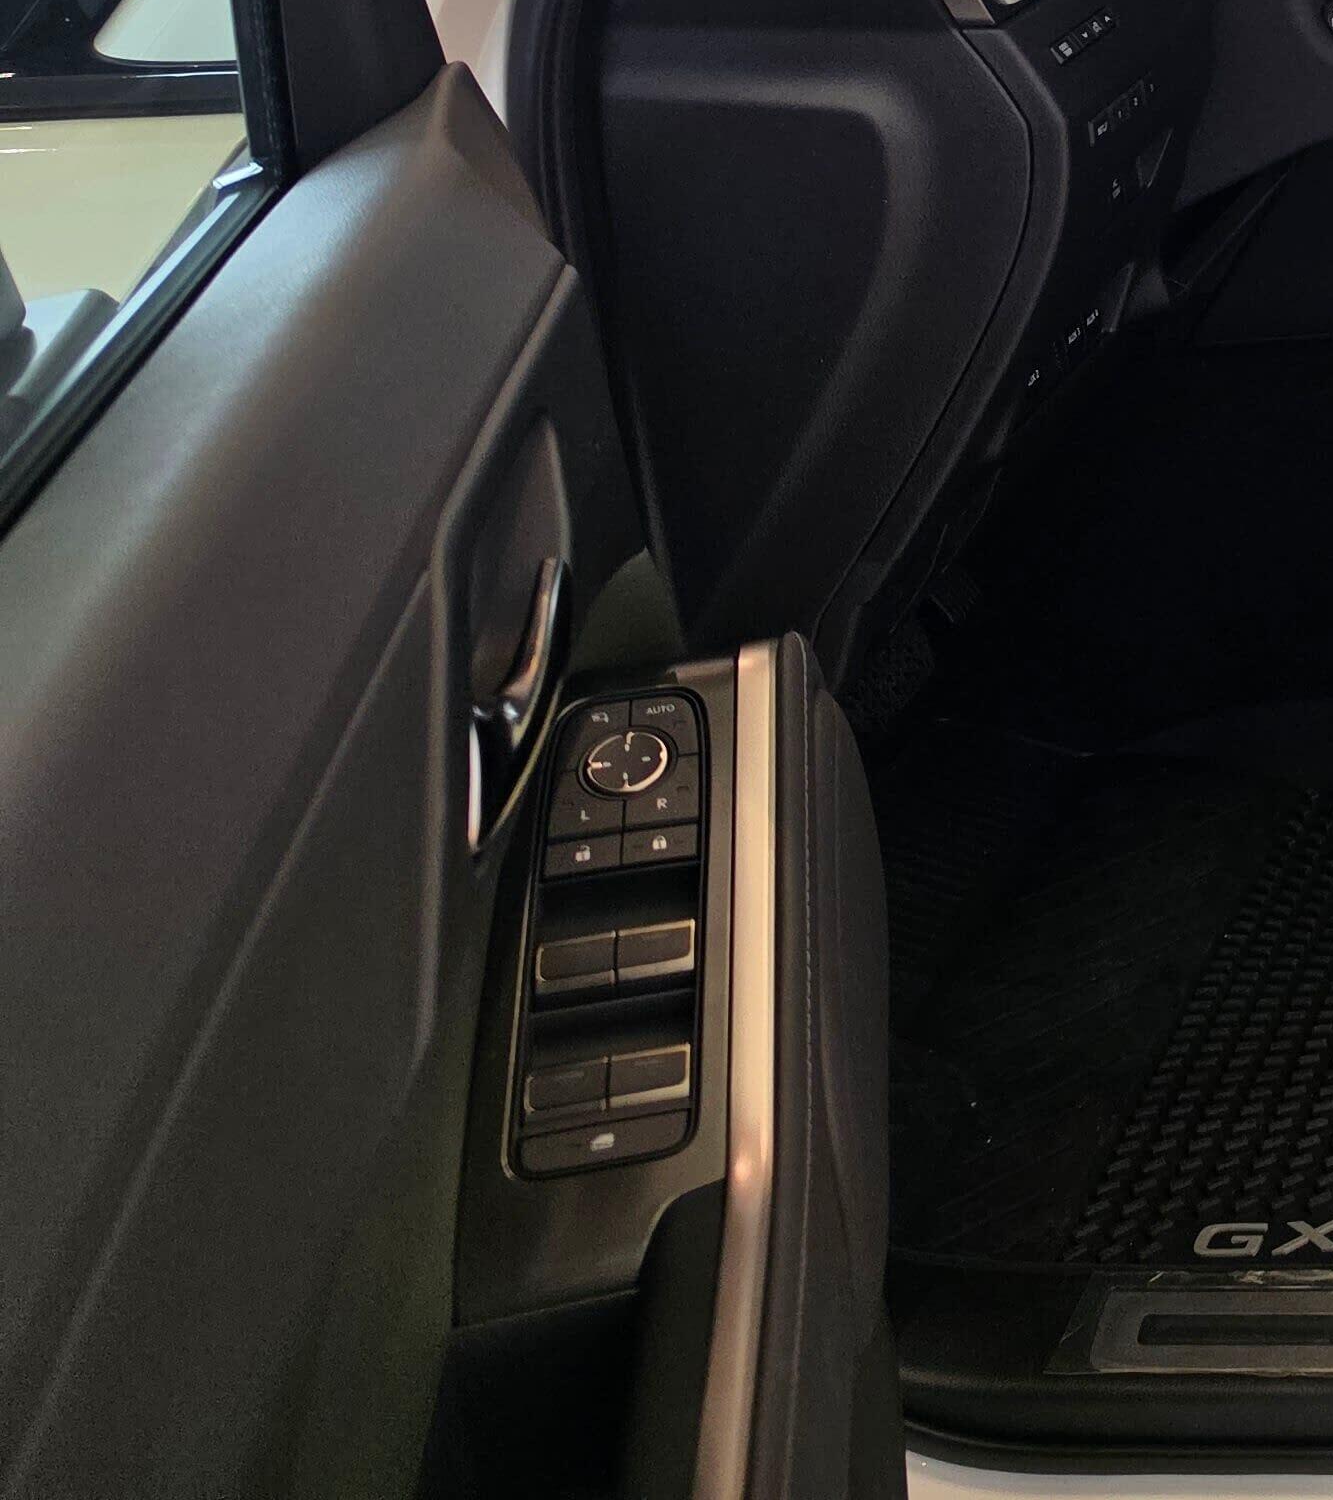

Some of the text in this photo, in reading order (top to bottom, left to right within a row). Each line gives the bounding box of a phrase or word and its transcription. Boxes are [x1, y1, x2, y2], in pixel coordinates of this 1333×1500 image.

[646, 703, 675, 715] AUTO
[657, 797, 668, 810] R
[580, 809, 590, 820] L
